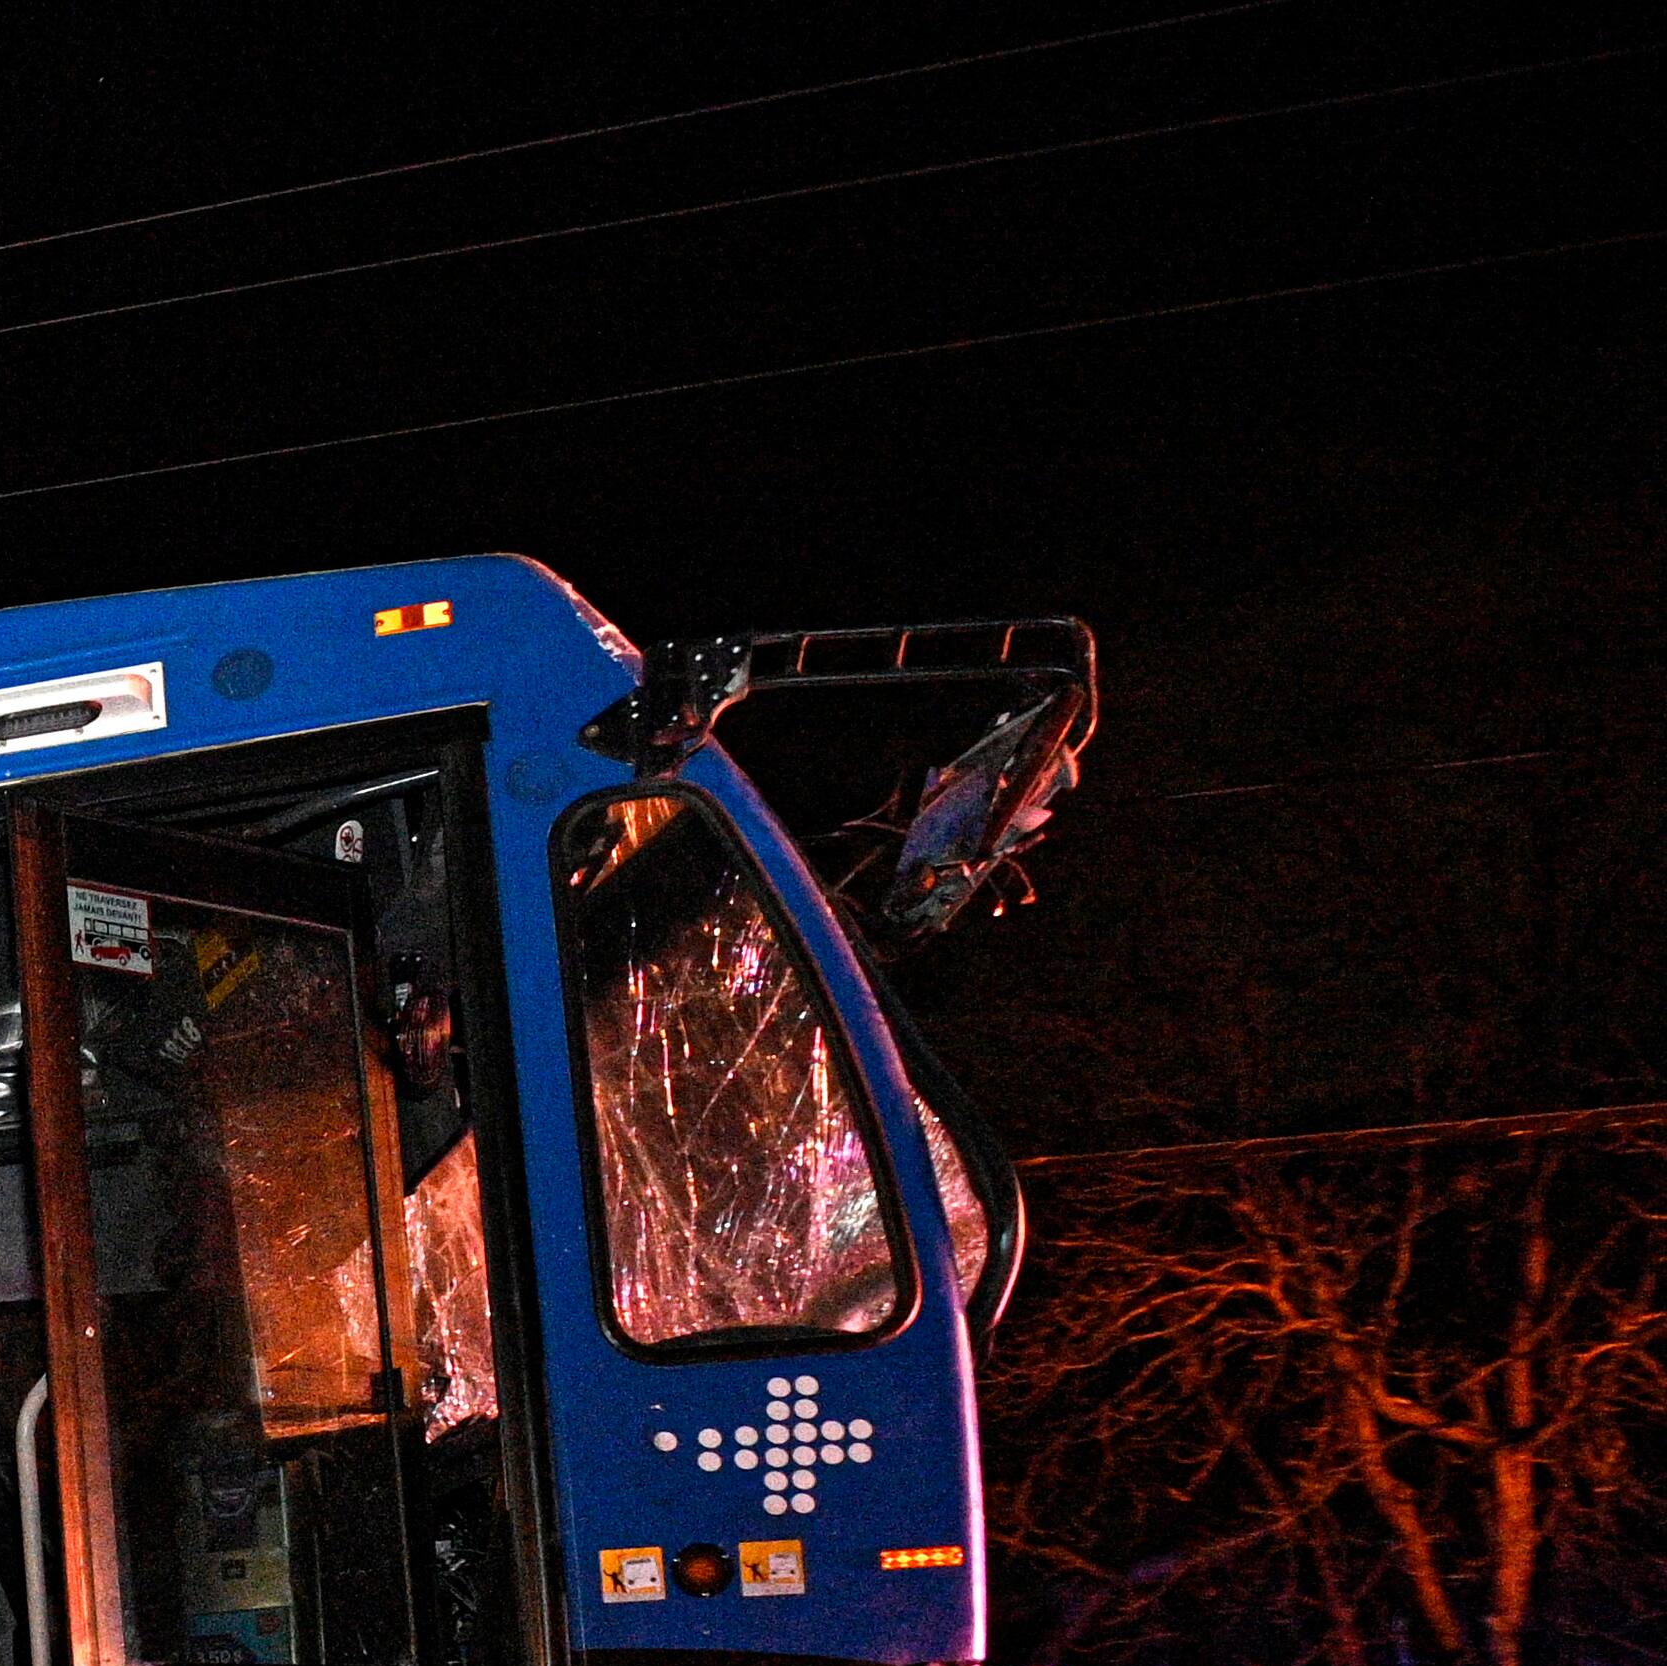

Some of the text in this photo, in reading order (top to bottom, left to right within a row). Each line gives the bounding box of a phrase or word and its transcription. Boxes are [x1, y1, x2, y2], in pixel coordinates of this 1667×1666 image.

[73, 902, 105, 917] JAMAIS
[75, 891, 139, 911] NE TRAVERSEZ
